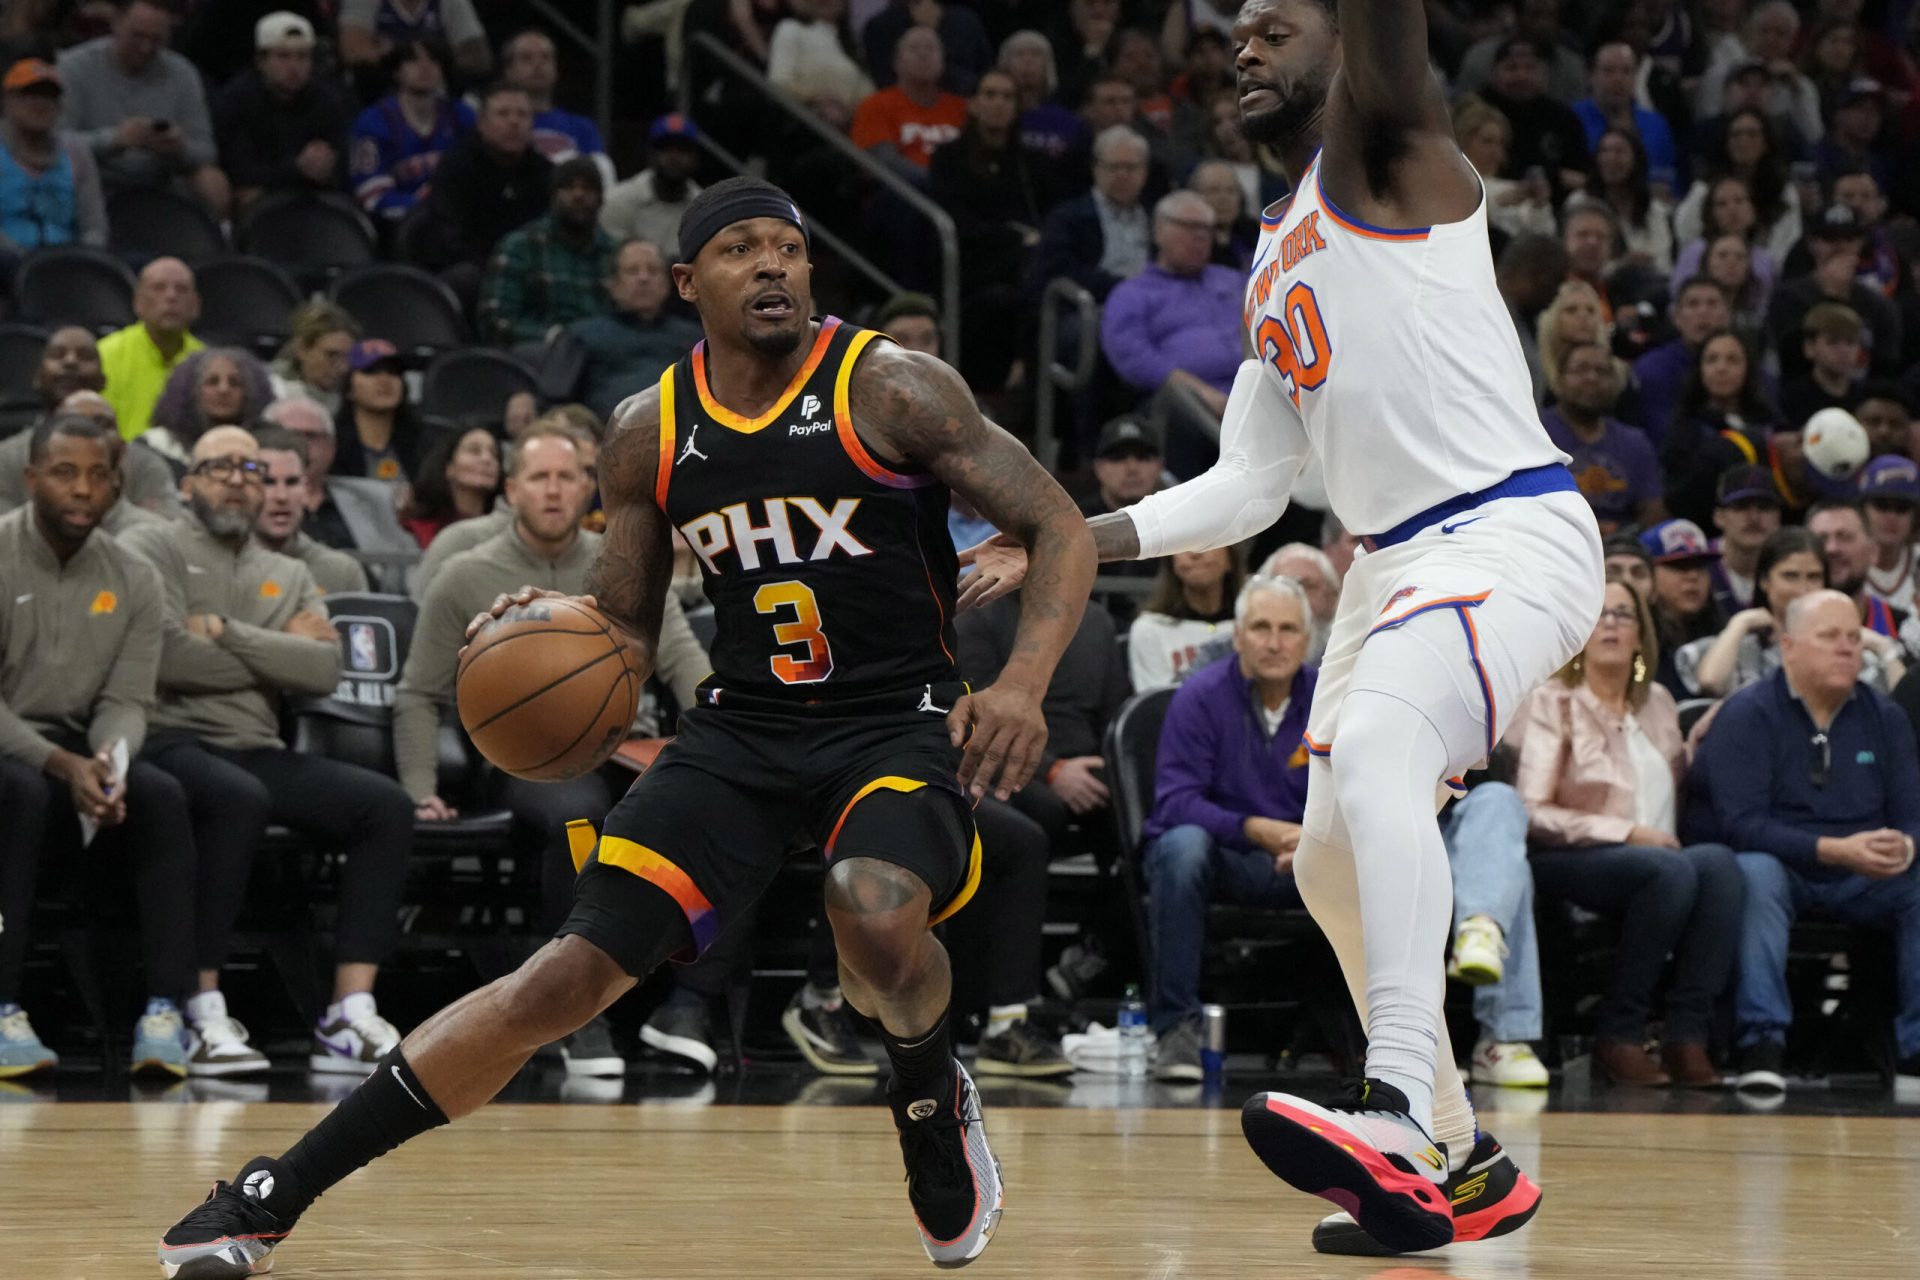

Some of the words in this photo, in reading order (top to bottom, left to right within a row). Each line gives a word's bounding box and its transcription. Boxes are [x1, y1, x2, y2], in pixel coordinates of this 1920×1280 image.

[1279, 210, 1327, 273] ORK
[1257, 280, 1333, 409] 30
[788, 419, 832, 436] PayPal
[679, 496, 877, 576] PHX
[753, 579, 835, 686] 3
